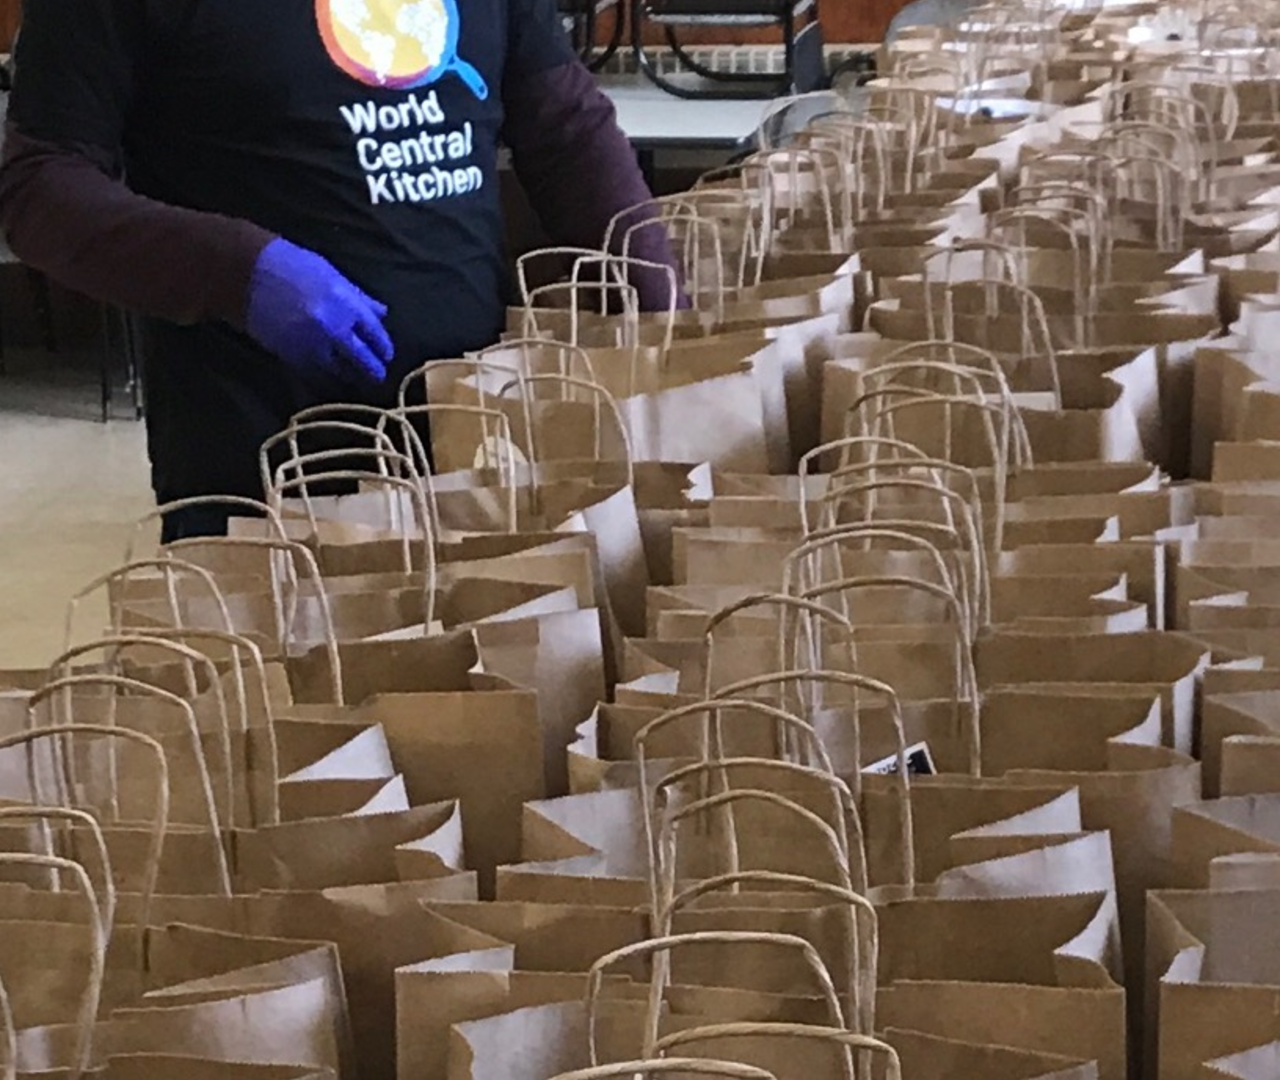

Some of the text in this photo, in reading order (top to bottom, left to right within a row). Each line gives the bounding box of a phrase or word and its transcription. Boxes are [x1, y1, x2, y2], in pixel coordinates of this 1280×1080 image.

[339, 90, 445, 135] World
[356, 122, 473, 171] Central
[366, 165, 483, 205] Kitchen
